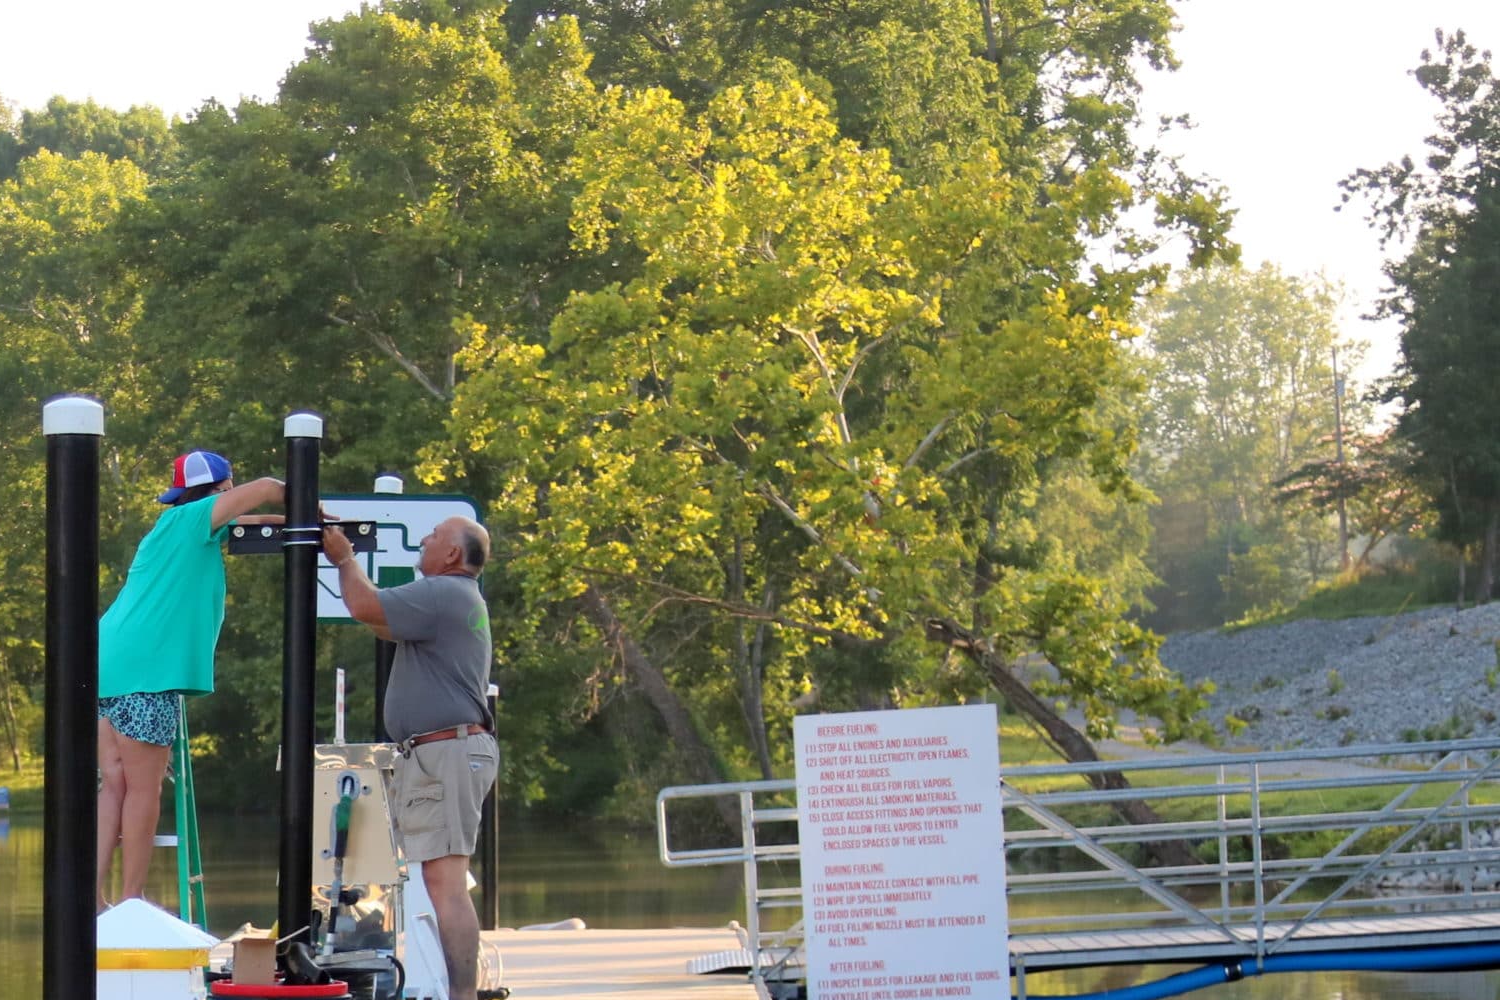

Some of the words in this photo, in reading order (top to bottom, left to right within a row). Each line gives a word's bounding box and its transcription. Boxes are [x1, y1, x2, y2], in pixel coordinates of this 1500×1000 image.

[818, 726, 844, 736] BEFORE
[806, 744, 816, 753] (1)
[818, 742, 836, 752] STOP
[838, 742, 852, 751] ALL
[853, 740, 884, 750] ENGINES
[886, 738, 901, 748] AND
[806, 758, 817, 768] (2)
[820, 757, 838, 766] SHUT
[840, 756, 852, 766] OFF
[854, 755, 868, 764] ALL
[918, 751, 937, 760] OPEN
[820, 770, 836, 780] AND
[837, 770, 854, 779] HEAT
[808, 786, 818, 795] (3)
[820, 784, 844, 794] CHECK
[846, 784, 860, 792] ALL
[861, 782, 886, 792] BILGES
[888, 781, 902, 790] FOR
[904, 780, 920, 789] FUEL
[809, 800, 819, 808] (4)
[821, 797, 864, 808] EXTINGUISH
[866, 796, 878, 805] ALL
[881, 794, 914, 804] SMOKING
[810, 814, 820, 822] (5)
[822, 812, 844, 822] CLOSE
[846, 810, 874, 820] ACCESS
[876, 808, 908, 818] FITTINGS
[910, 806, 924, 816] AND
[926, 805, 962, 816] OPENINGS
[964, 803, 982, 813] THAT
[823, 826, 846, 836] COULD
[848, 825, 872, 834] ALLOW
[874, 824, 891, 832] FUEL
[894, 822, 922, 832] VAPORS
[924, 821, 932, 830] TO
[935, 820, 958, 830] ENTER
[824, 840, 860, 850] ENCLOSED
[862, 838, 890, 848] SPACES
[892, 838, 900, 846] OF
[903, 836, 916, 846] THE
[825, 865, 852, 876] DURING
[826, 881, 860, 891] MAINTAIN
[863, 880, 889, 889] NOZZLE
[892, 877, 924, 888] CONTACT
[926, 876, 944, 886] WITH
[946, 875, 961, 885] FILL
[826, 896, 844, 905] WIPE
[846, 895, 856, 904] UP
[858, 894, 881, 903] SPILLS
[828, 910, 848, 919] AVOID
[828, 923, 844, 932] FUEL
[848, 922, 874, 932] FILLING
[876, 920, 902, 930] NOZZLE
[905, 918, 924, 928] MUST
[927, 918, 936, 928] BE
[938, 916, 975, 926] ATTENDED
[977, 914, 986, 924] AT
[828, 938, 842, 947] ALL
[830, 962, 852, 972] AFTER
[831, 978, 860, 988] INSPECT
[862, 976, 888, 986] BILGES
[890, 976, 903, 985] FOR
[905, 974, 936, 984] LEAKAGE
[940, 972, 954, 982] AND
[956, 972, 972, 982] FUEL
[872, 990, 891, 1000] UNTIL
[894, 988, 917, 998] ODORS
[920, 988, 932, 997] ARE
